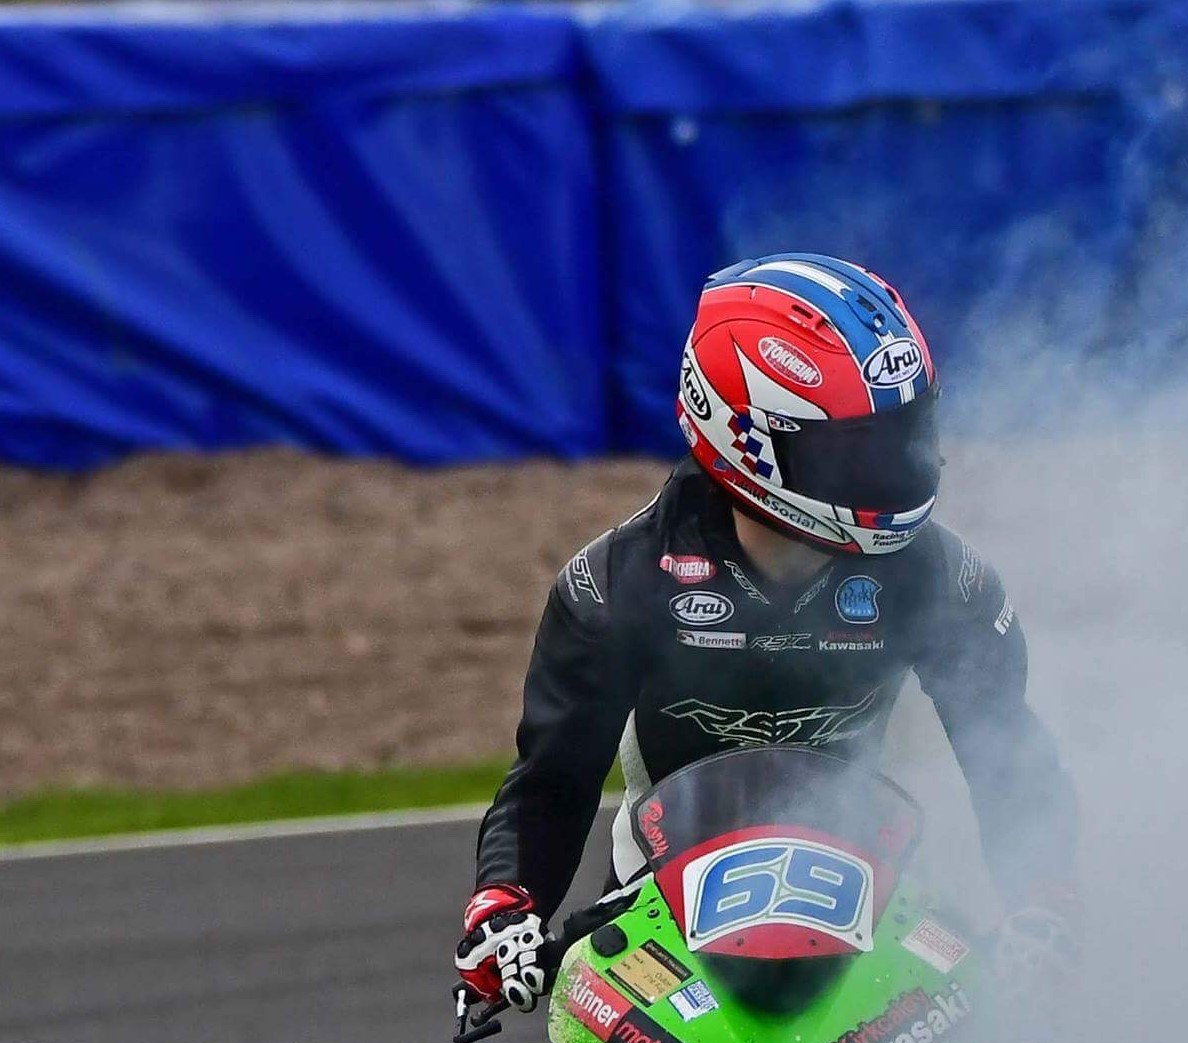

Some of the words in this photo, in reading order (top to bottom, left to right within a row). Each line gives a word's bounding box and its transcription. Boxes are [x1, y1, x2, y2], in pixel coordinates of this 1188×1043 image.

[760, 339, 821, 386] TOKHEIM
[871, 342, 919, 384] Arai
[665, 556, 711, 578] TKHEIM
[674, 596, 723, 616] Arai
[751, 632, 812, 650] RST
[818, 639, 885, 651] Kawasaki
[661, 683, 884, 747] RST
[695, 846, 865, 934] 69
[563, 970, 620, 1028] kinner
